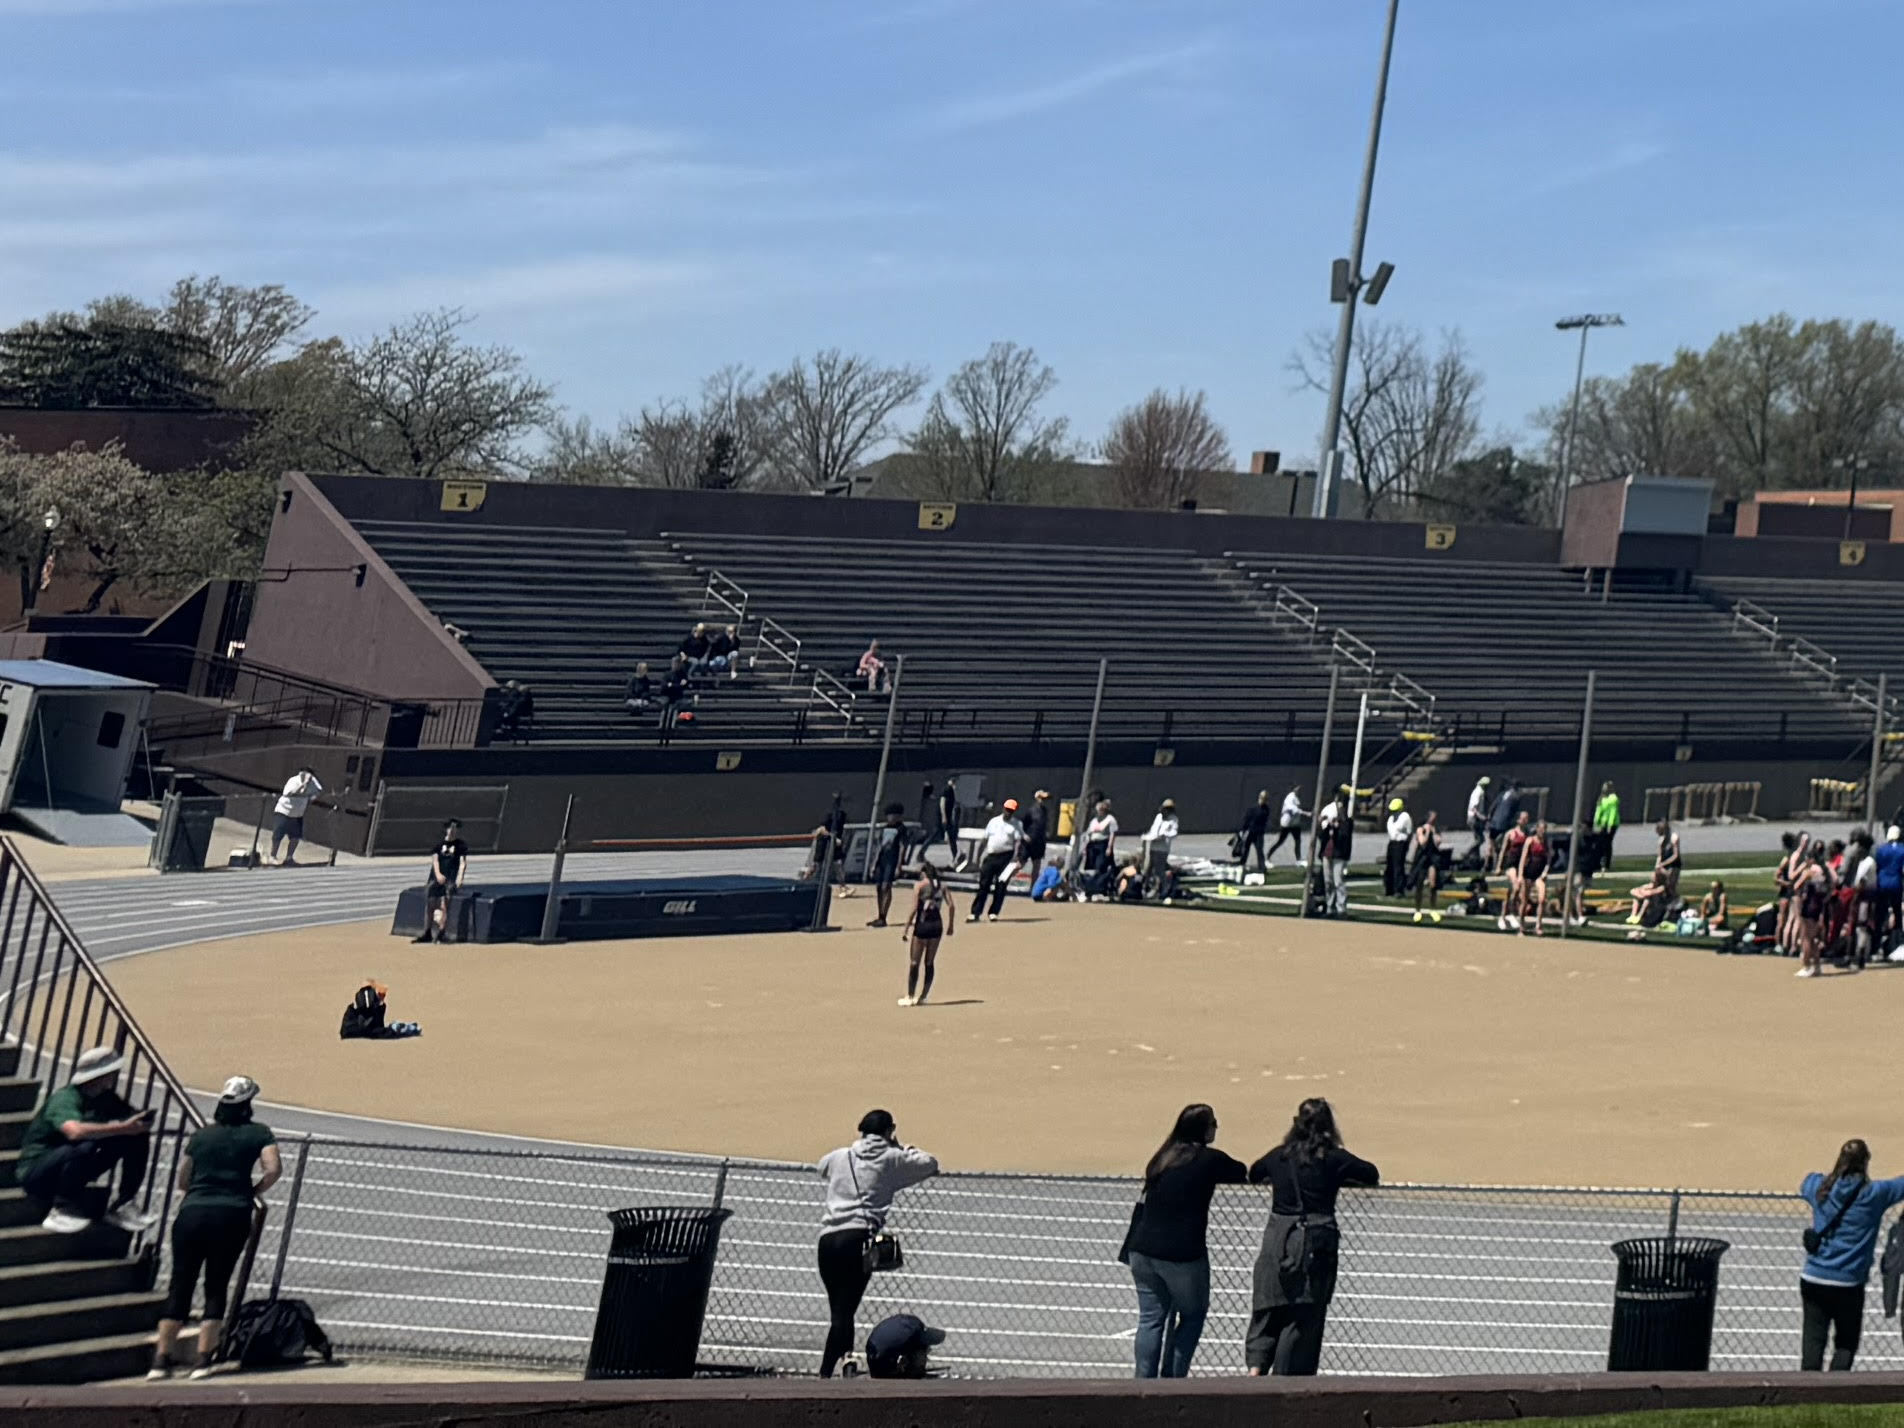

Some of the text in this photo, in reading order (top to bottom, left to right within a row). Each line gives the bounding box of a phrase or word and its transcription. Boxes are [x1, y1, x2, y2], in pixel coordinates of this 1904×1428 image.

[457, 492, 469, 508] 1
[931, 511, 944, 526] 2
[1435, 532, 1446, 546] 3
[663, 900, 697, 914] GILL
